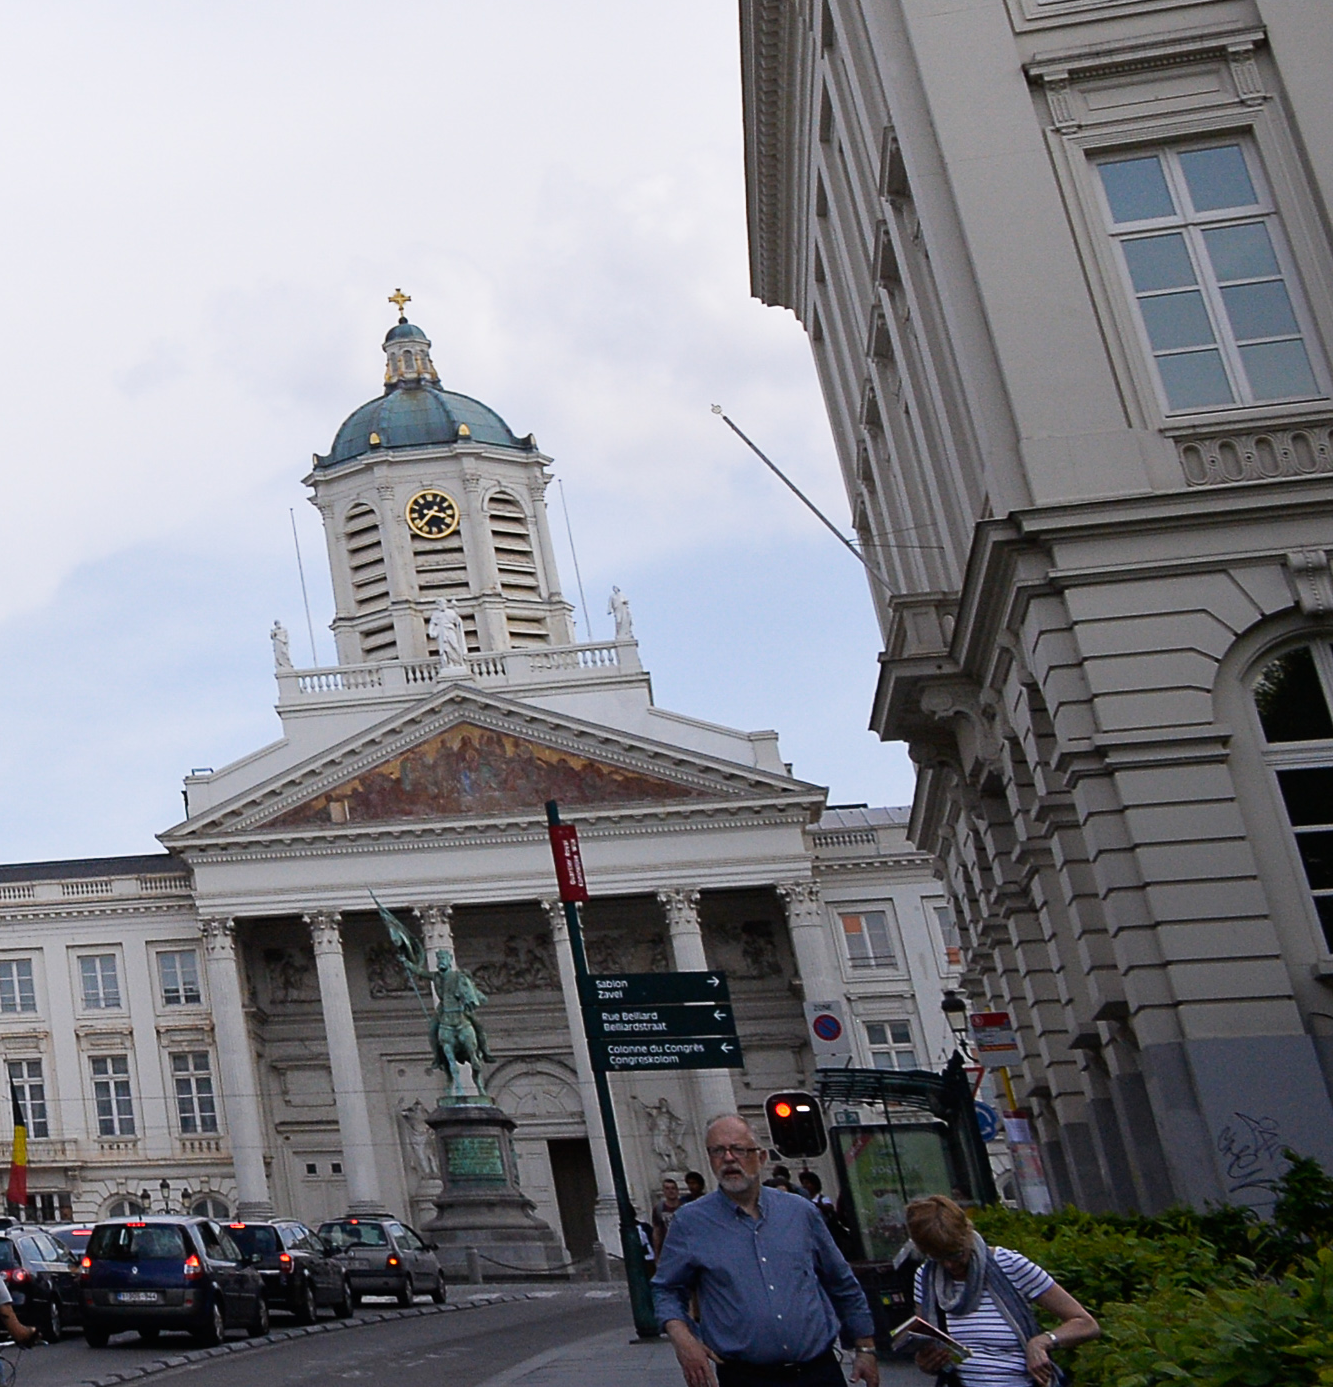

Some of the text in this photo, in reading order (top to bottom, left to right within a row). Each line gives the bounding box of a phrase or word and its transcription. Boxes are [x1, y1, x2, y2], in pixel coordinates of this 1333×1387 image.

[595, 979, 629, 989] Sablon
[597, 990, 624, 999] Zavel
[813, 1004, 832, 1012] ZONE
[601, 1011, 659, 1021] Rue Belliard
[603, 1022, 668, 1031] Belliardstraat
[607, 1043, 705, 1054] Colonne du Congrès
[609, 1055, 680, 1065] Congreskolom
